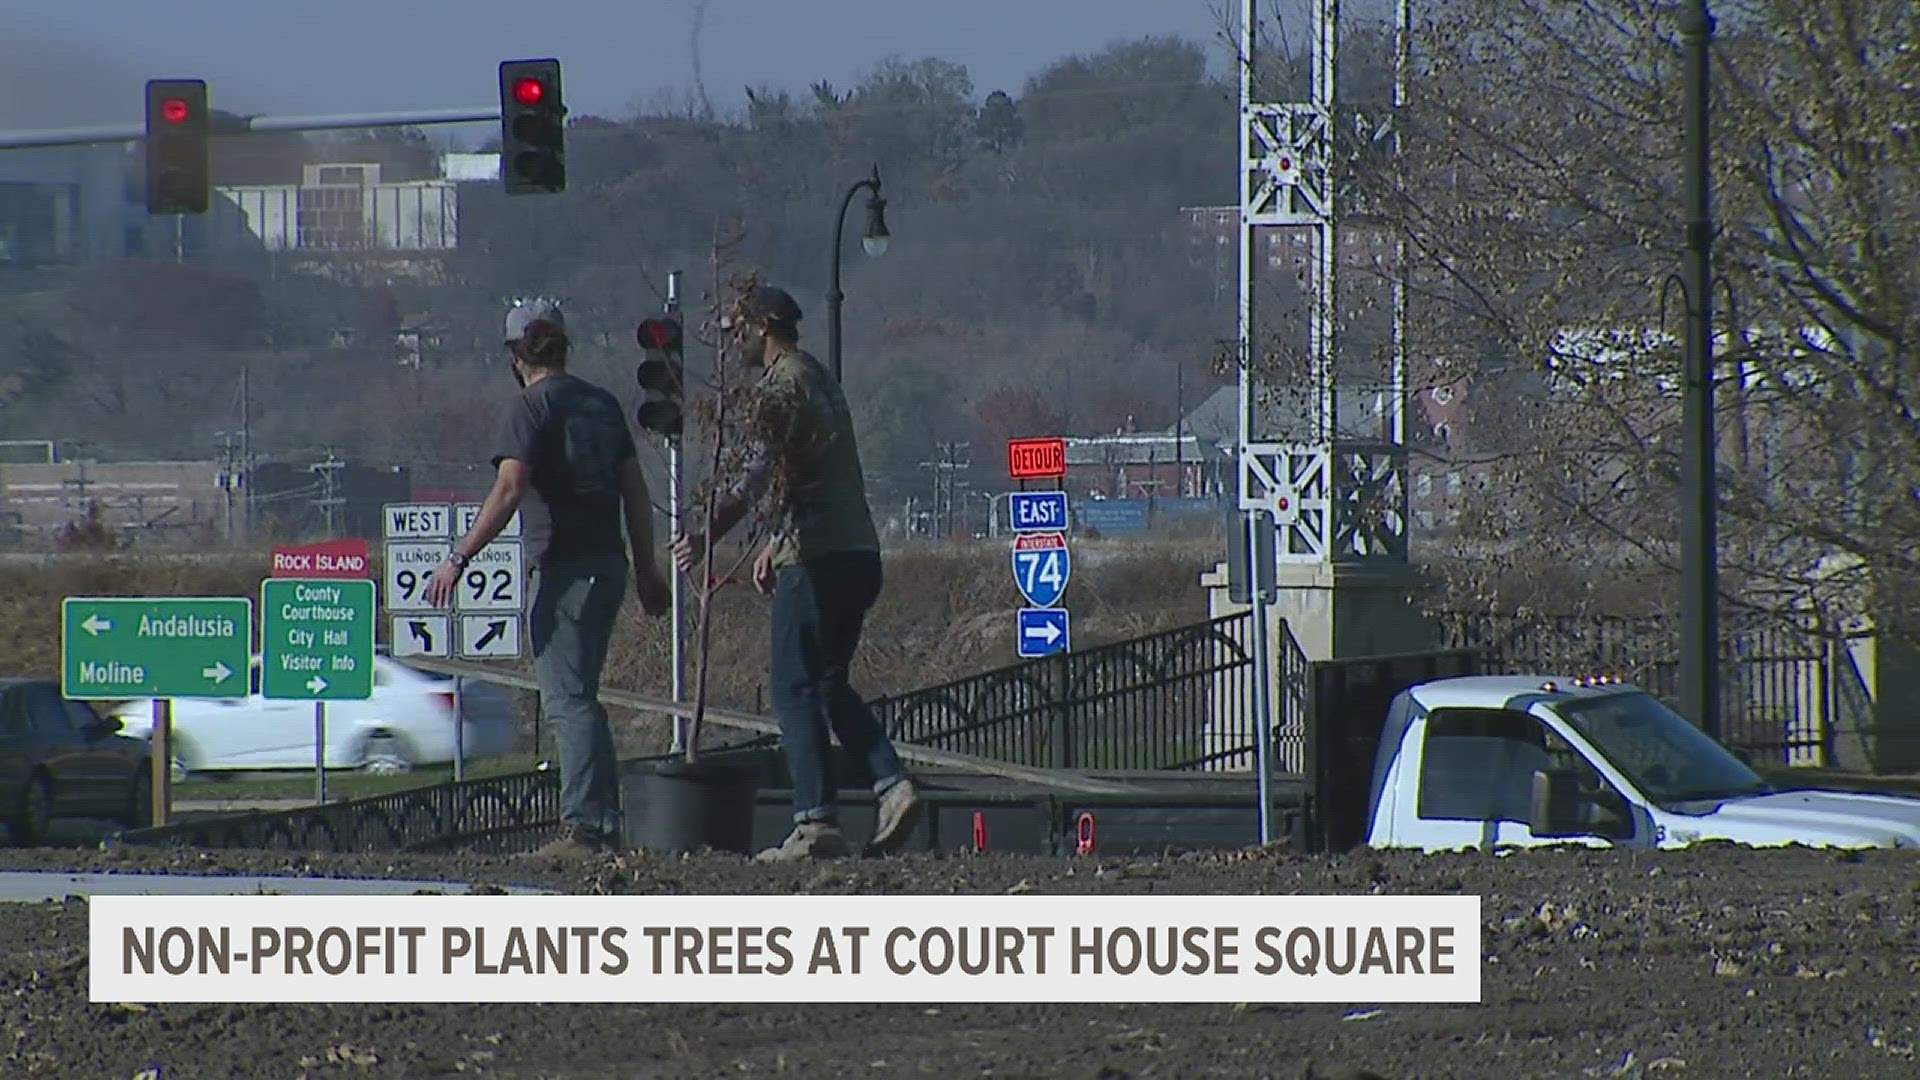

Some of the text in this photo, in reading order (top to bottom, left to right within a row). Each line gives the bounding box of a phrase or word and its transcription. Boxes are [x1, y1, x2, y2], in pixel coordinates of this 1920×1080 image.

[1013, 446, 1062, 470] DETOUR
[393, 512, 441, 532] WEST
[1020, 501, 1057, 523] EAST
[274, 554, 364, 571] ROCK ISLAND
[395, 552, 442, 563] ILLINOIS
[470, 552, 512, 563] LINOIS
[1019, 553, 1062, 593] 74
[295, 584, 341, 604] County
[467, 569, 512, 600] 92
[282, 604, 355, 621] Courthouse
[138, 614, 234, 637] Andalusia
[288, 629, 348, 648] City Hall
[79, 661, 144, 684] Moline
[281, 654, 355, 671] Visitor Info
